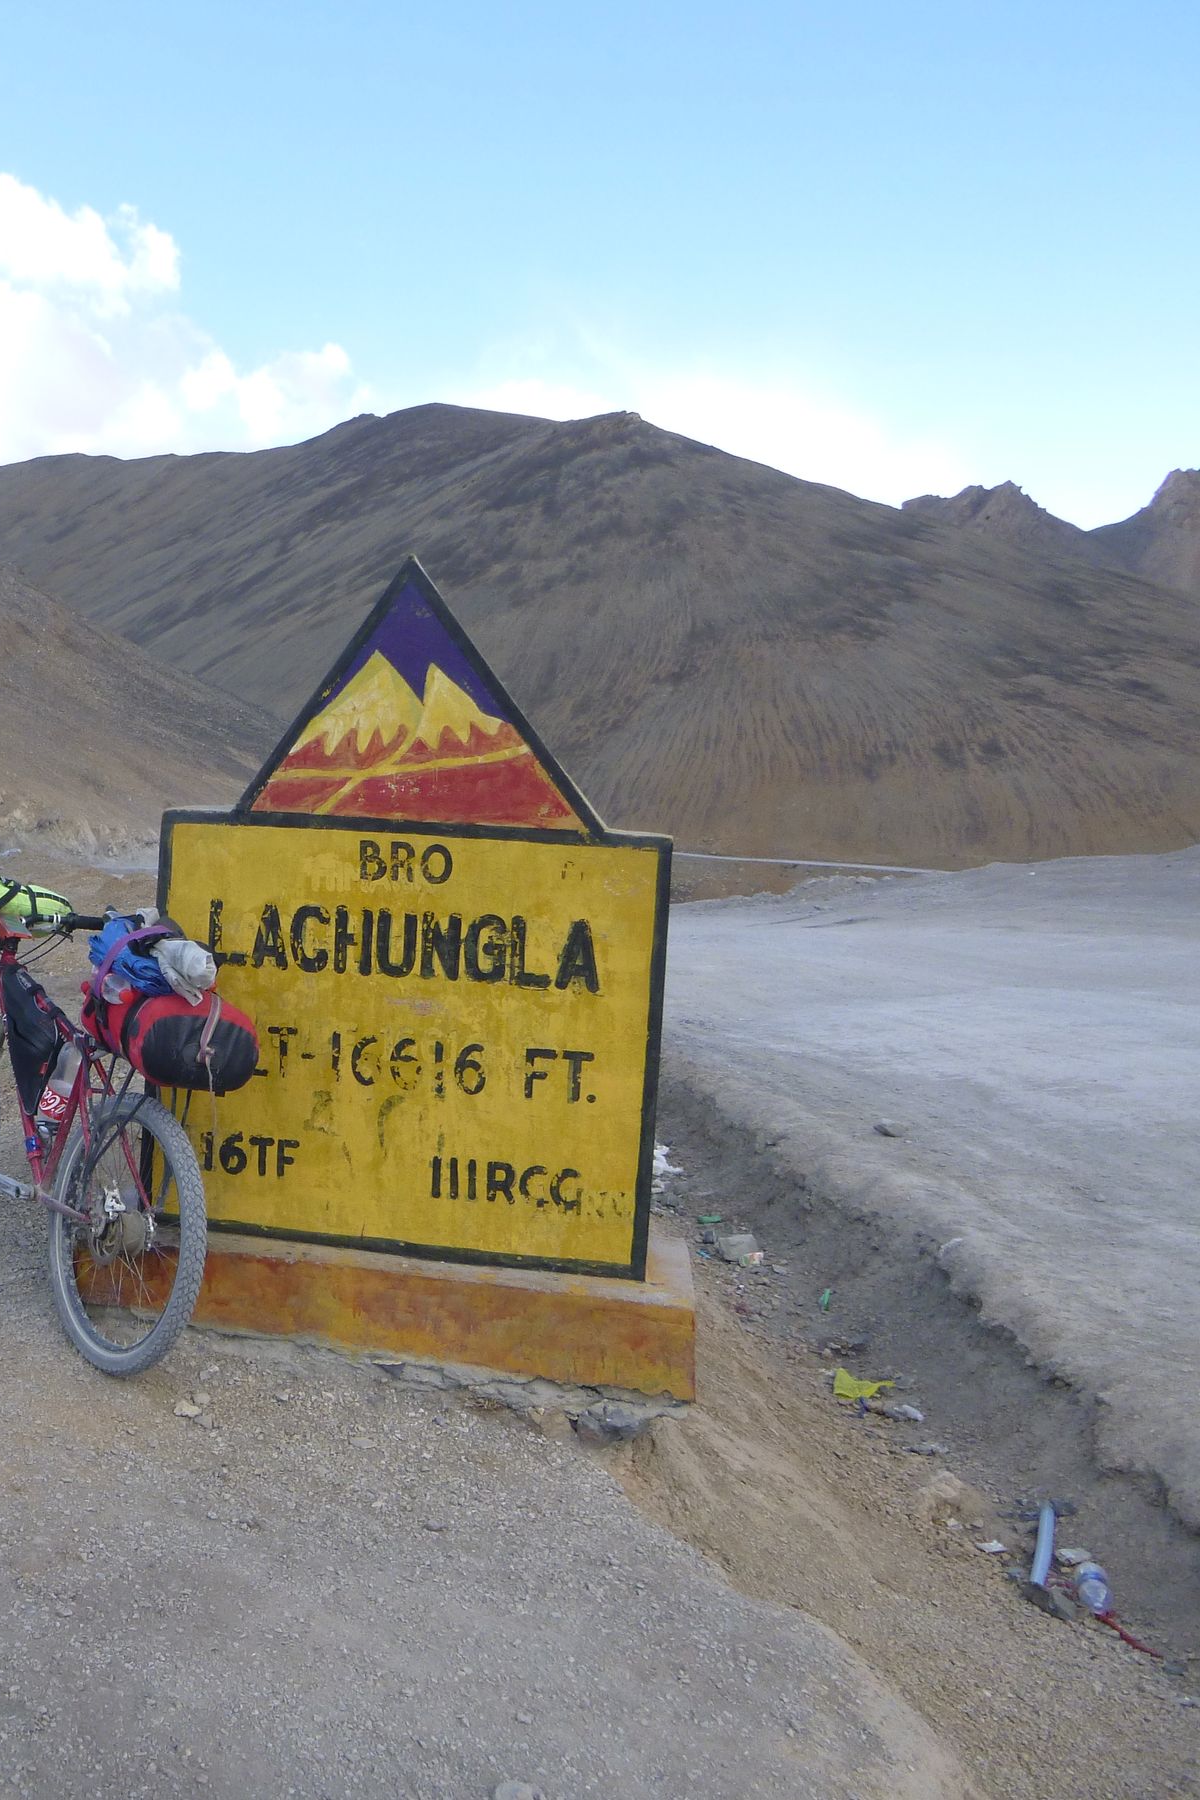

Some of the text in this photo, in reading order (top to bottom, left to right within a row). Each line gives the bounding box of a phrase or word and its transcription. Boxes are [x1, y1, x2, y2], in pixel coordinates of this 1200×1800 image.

[359, 839, 453, 885] BRO
[207, 899, 599, 991] LACHUNGLA
[524, 1048, 597, 1104] FT.
